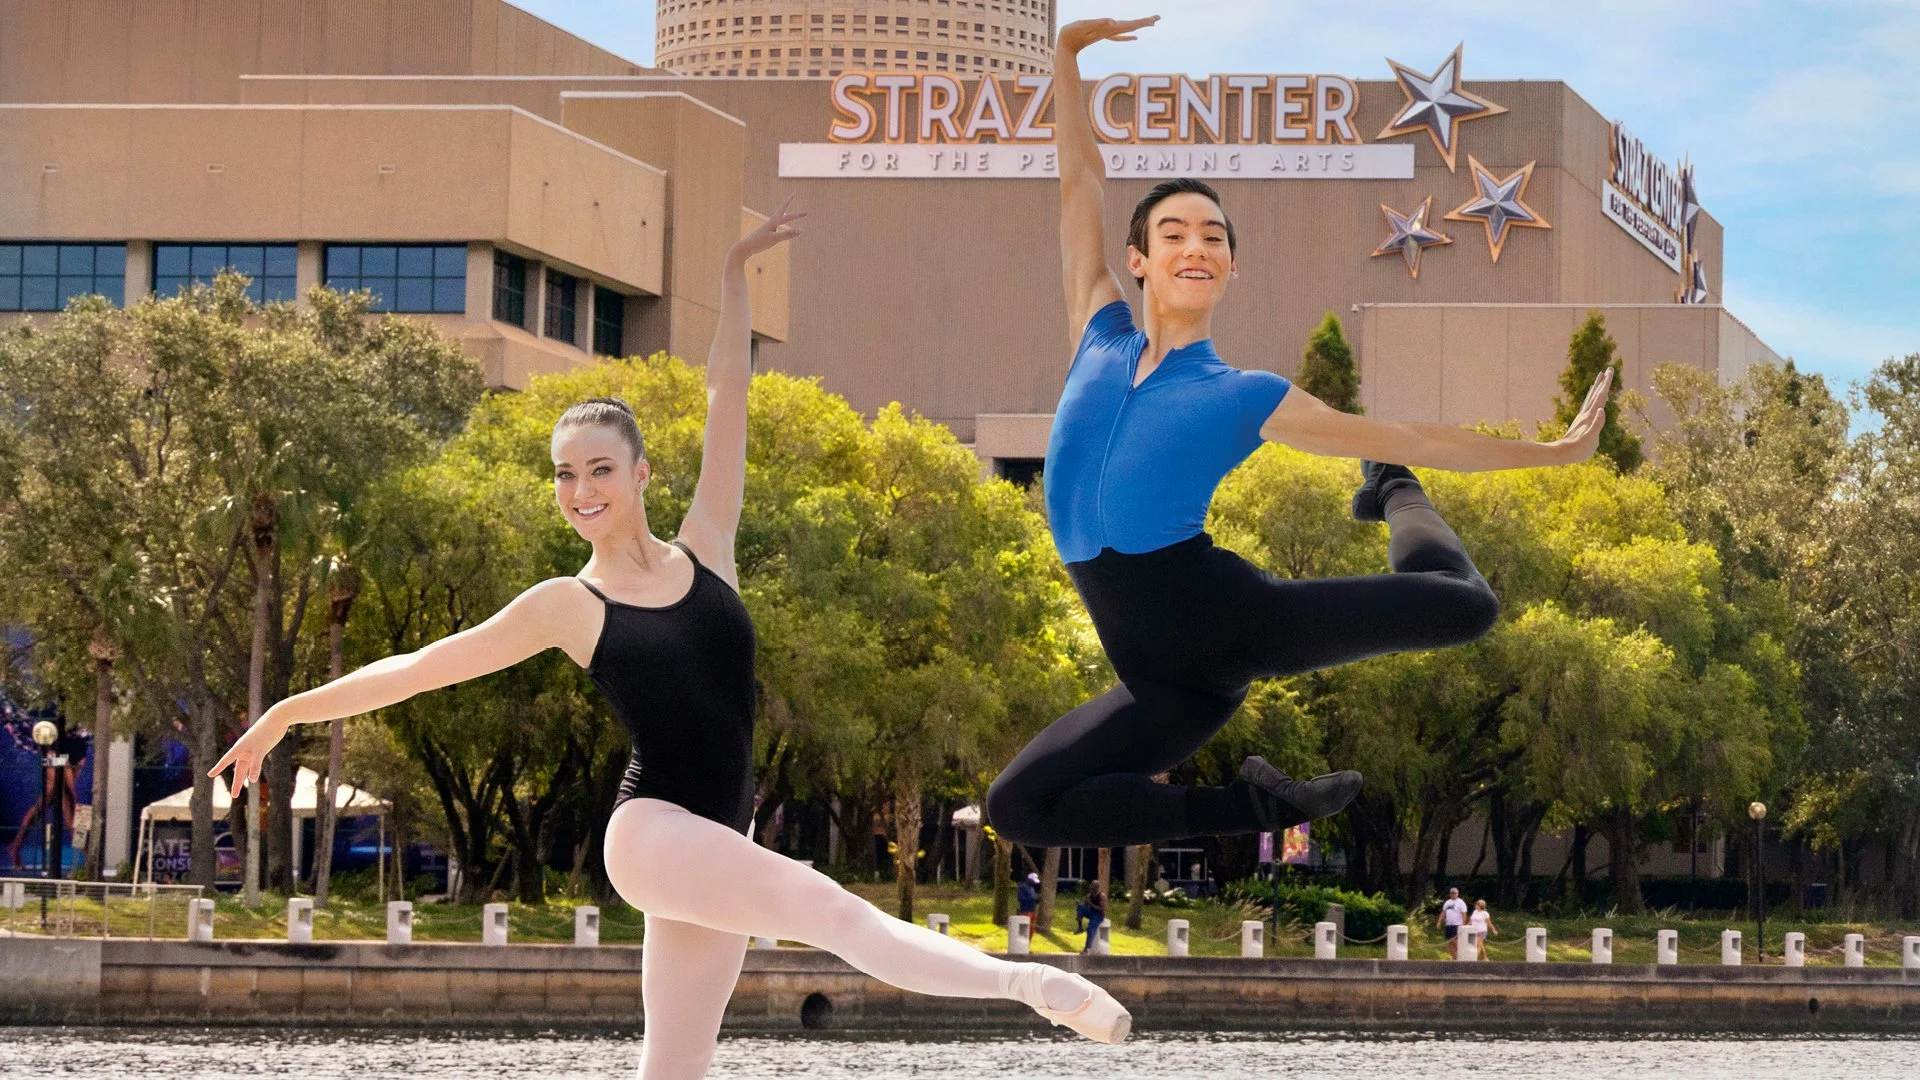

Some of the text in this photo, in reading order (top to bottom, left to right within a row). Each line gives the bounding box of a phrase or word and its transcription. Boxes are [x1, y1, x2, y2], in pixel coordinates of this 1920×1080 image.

[830, 72, 1362, 143] STRAZ CENTER
[838, 151, 1355, 171] FOR THE PEORMING ARTS
